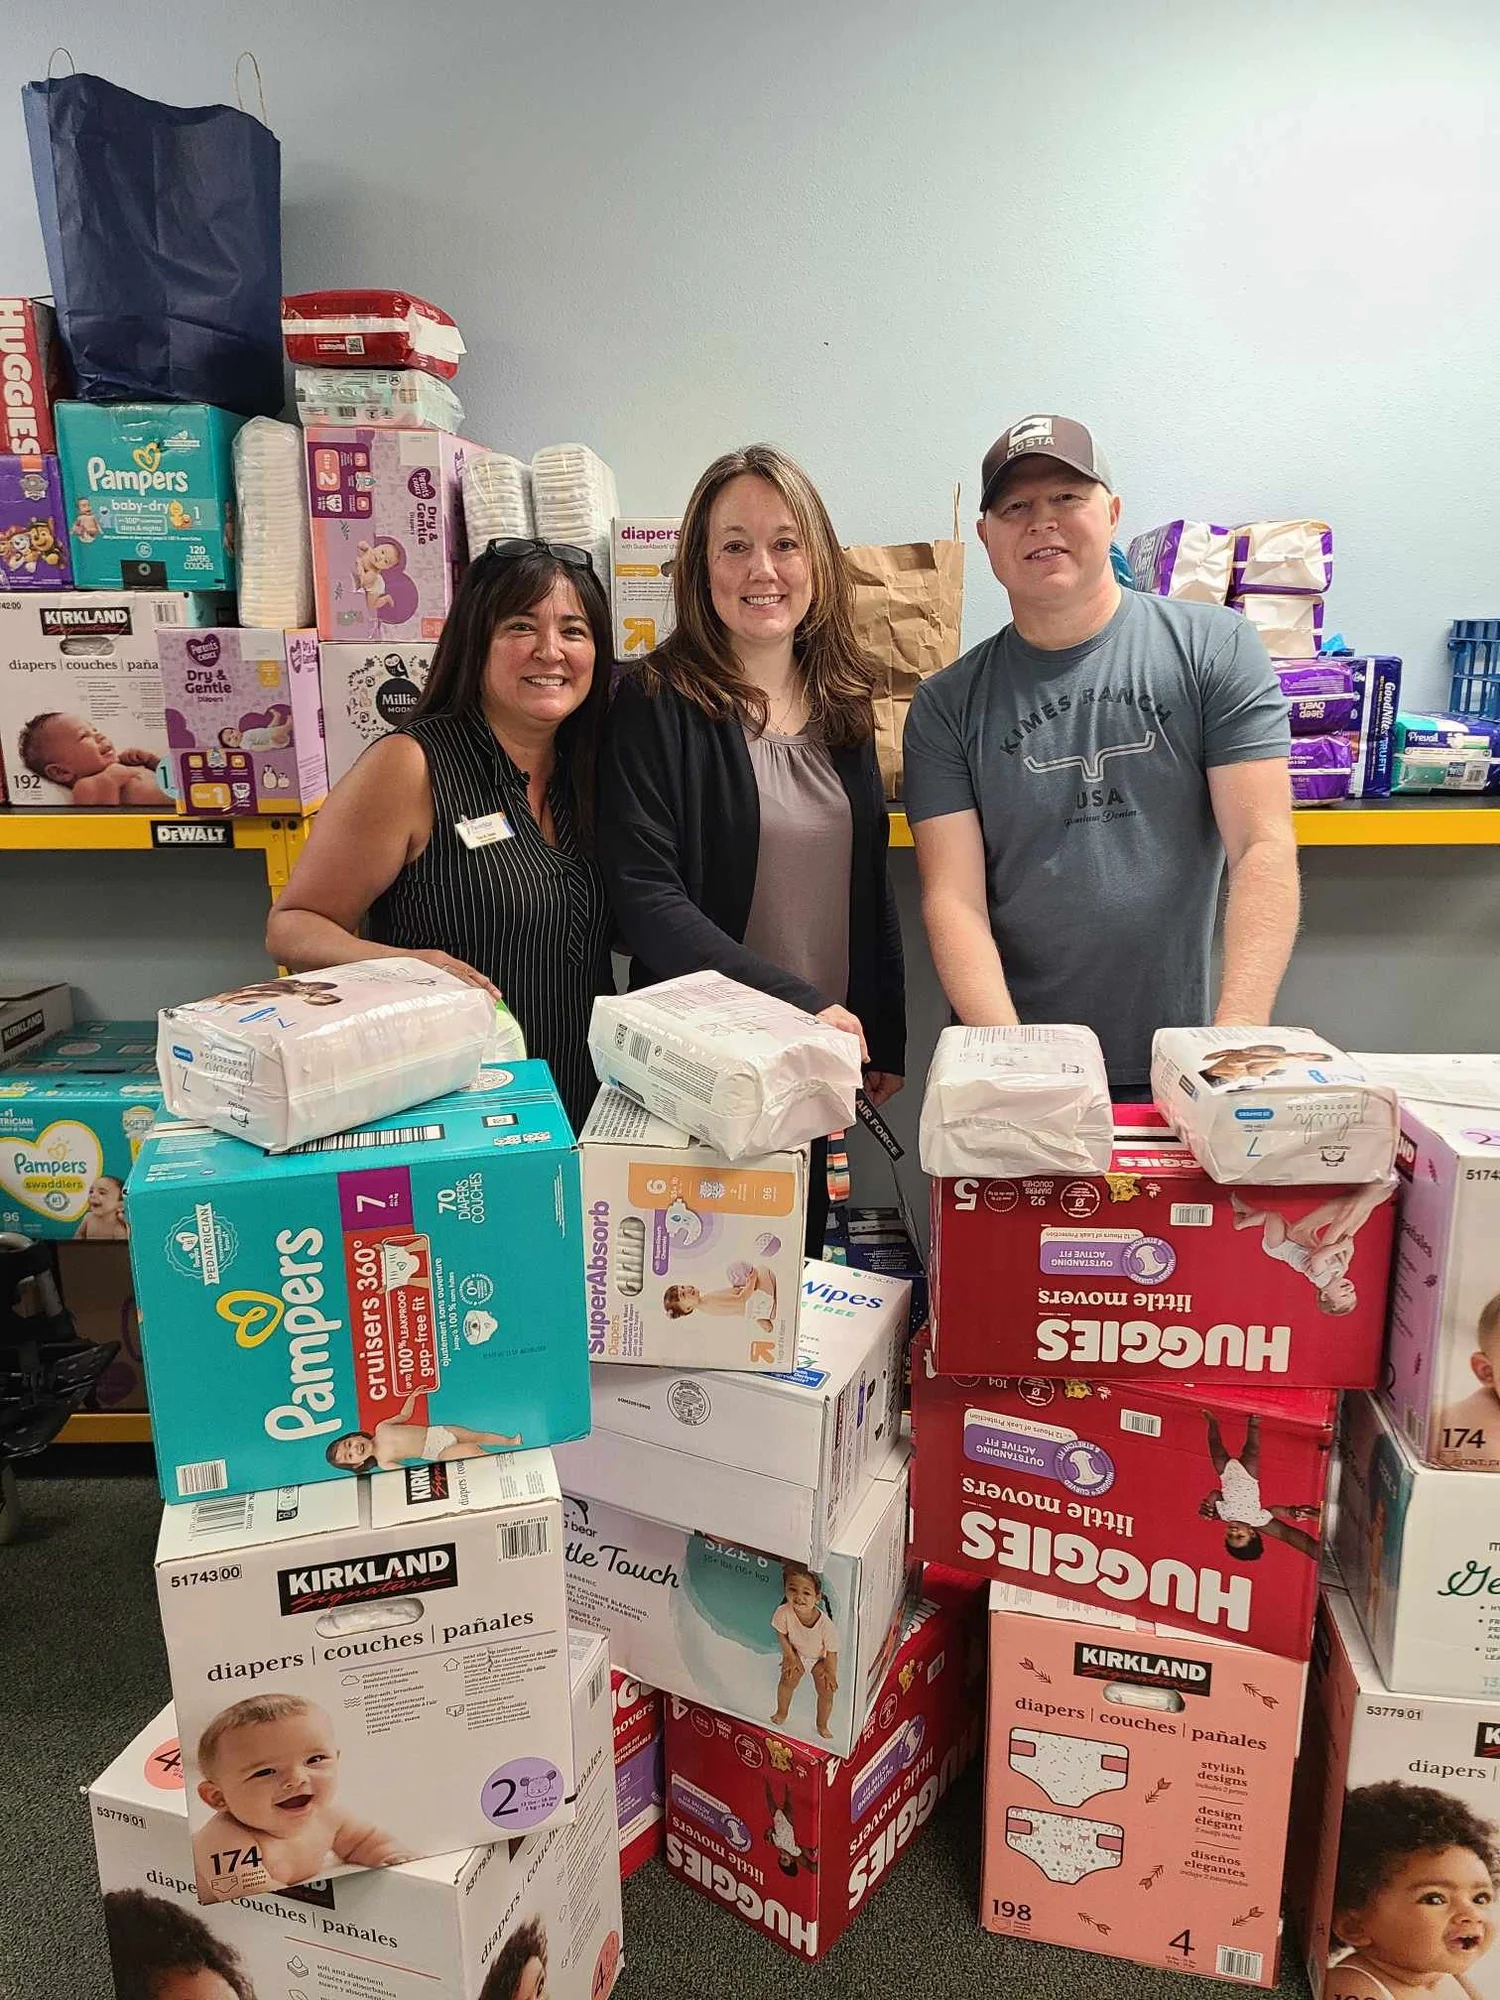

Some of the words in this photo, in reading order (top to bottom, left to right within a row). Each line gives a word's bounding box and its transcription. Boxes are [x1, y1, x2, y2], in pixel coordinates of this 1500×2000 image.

[0, 299, 40, 454] HUGGIES
[1006, 436, 1055, 459] COSTA
[87, 456, 189, 496] Pampers
[318, 471, 337, 486] 2
[111, 499, 170, 514] baby-dry
[427, 506, 437, 529] Dry
[417, 503, 428, 545] Gentle
[621, 527, 681, 543] diapers
[429, 533, 438, 542] &
[189, 545, 206, 555] 120
[44, 610, 129, 625] KIRKLAND
[9, 660, 57, 674] diapers
[66, 659, 118, 671] couches
[187, 670, 213, 684] Dry
[216, 670, 228, 681] &
[185, 681, 232, 695] Gentle
[382, 694, 418, 706] Millie
[1381, 682, 1396, 736] GoodNites
[1000, 698, 1073, 757] KIMES
[1083, 688, 1172, 725] RANCH
[1408, 732, 1438, 742] Prevail
[14, 775, 42, 789] 192
[160, 766, 169, 789] 1
[1077, 788, 1123, 809] USA
[4, 1011, 43, 1041] KIRKLAND
[855, 1099, 873, 1123] AIR
[870, 1118, 899, 1157] FORCE
[1246, 1137, 1262, 1157] 7
[14, 1152, 87, 1176] Pampers
[24, 1178, 84, 1189] swaddlers
[646, 1178, 667, 1195] 6
[954, 1178, 978, 1211] 5
[1022, 1180, 1054, 1188] COUCHES
[357, 1194, 387, 1213] 7
[437, 1189, 457, 1214] 70
[456, 1180, 470, 1220] DIAPERS
[469, 1173, 485, 1223] COUCHES
[1030, 1196, 1046, 1206] 92
[201, 1208, 217, 1280] PEDIATRICIAN
[1058, 1250, 1072, 1258] FIT
[1074, 1251, 1106, 1259] ACTIVE
[353, 1239, 378, 1292] 360°
[1051, 1259, 1113, 1267] OUTSTANDING
[434, 1258, 443, 1300] ouverture
[587, 1200, 610, 1355] SuperAbsorb
[412, 1295, 426, 1316] fit
[438, 1300, 446, 1319] sans
[1038, 1290, 1128, 1306] movers
[1133, 1292, 1192, 1313] little
[397, 1290, 409, 1340] LEAKPROOF
[448, 1312, 458, 1331] 100
[813, 1304, 857, 1318] FREE
[264, 1227, 342, 1441] Pampers
[608, 1314, 621, 1356] Diapers
[360, 1297, 387, 1401] cruisers
[398, 1339, 415, 1375] 100%
[415, 1317, 434, 1378] gap-free
[1037, 1319, 1291, 1373] HUGGIES
[988, 1377, 1008, 1389] 104
[969, 1413, 1005, 1426] Protection
[1006, 1420, 1022, 1430] Leak
[1023, 1424, 1031, 1432] of
[985, 1437, 999, 1448] FIT
[1033, 1427, 1054, 1437] Hours
[1054, 1431, 1063, 1439] 12
[1443, 1428, 1486, 1449] 174
[976, 1445, 1045, 1467] OUTSTANDING
[1001, 1439, 1036, 1456] ACTIVE
[456, 1477, 469, 1506] diapers
[962, 1477, 1061, 1514] movers
[571, 1520, 598, 1538] bear
[1067, 1502, 1136, 1538] little
[288, 1550, 450, 1595] KIRKLAND
[599, 1544, 680, 1589] Touch
[960, 1511, 1252, 1633] HUGGIES
[291, 1578, 450, 1612] Signature
[207, 1650, 304, 1683] diapers
[324, 1630, 423, 1662] couches
[442, 1609, 534, 1644] pañales
[1082, 1647, 1206, 1681] KIRKLAND
[1015, 1697, 1085, 1721] diapers
[1100, 1711, 1176, 1736] couches
[1191, 1725, 1268, 1752] pañales
[903, 1746, 934, 1789] little
[1200, 1761, 1245, 1776] stylish
[1409, 1759, 1487, 1779] diapers
[1197, 1771, 1248, 1788] designs
[491, 1778, 519, 1818] 2
[848, 1737, 980, 1911] HUGGIES
[849, 1787, 901, 1858] movers
[1198, 1806, 1242, 1821] design
[672, 1817, 726, 1859] movers
[210, 1846, 263, 1876] 174
[728, 1853, 766, 1885] little
[1185, 1859, 1246, 1878] elegantes
[1191, 1849, 1241, 1867] diseños
[666, 1833, 818, 1957] HUGGIES
[991, 1898, 1033, 1922] 198
[230, 1896, 307, 1925] couches
[323, 1918, 398, 1949] pañales
[481, 1891, 521, 1966] diapers
[1168, 1928, 1195, 1956] 4
